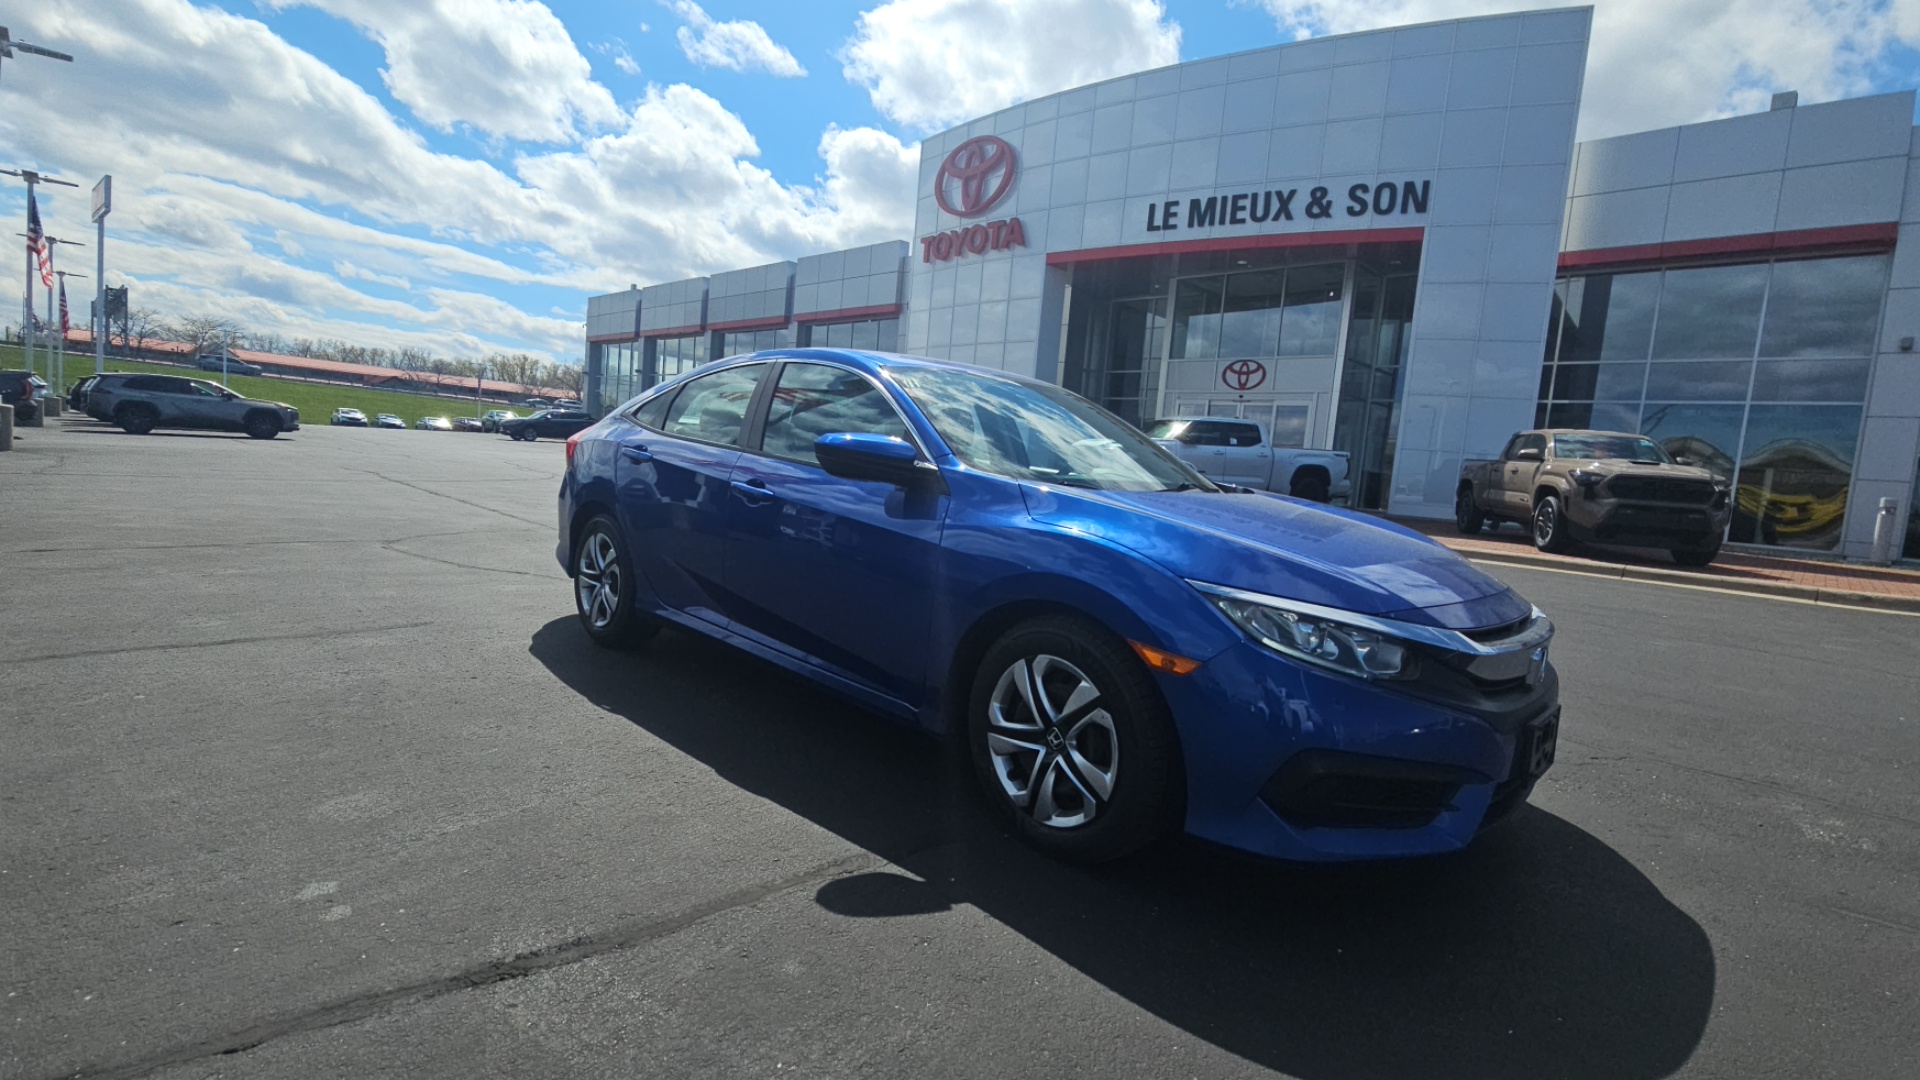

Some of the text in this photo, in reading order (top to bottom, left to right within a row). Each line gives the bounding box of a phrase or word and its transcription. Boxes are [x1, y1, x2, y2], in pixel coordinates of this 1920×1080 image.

[1146, 180, 1431, 232] LE MIEUX & SON
[920, 217, 1026, 264] TOYOTA
